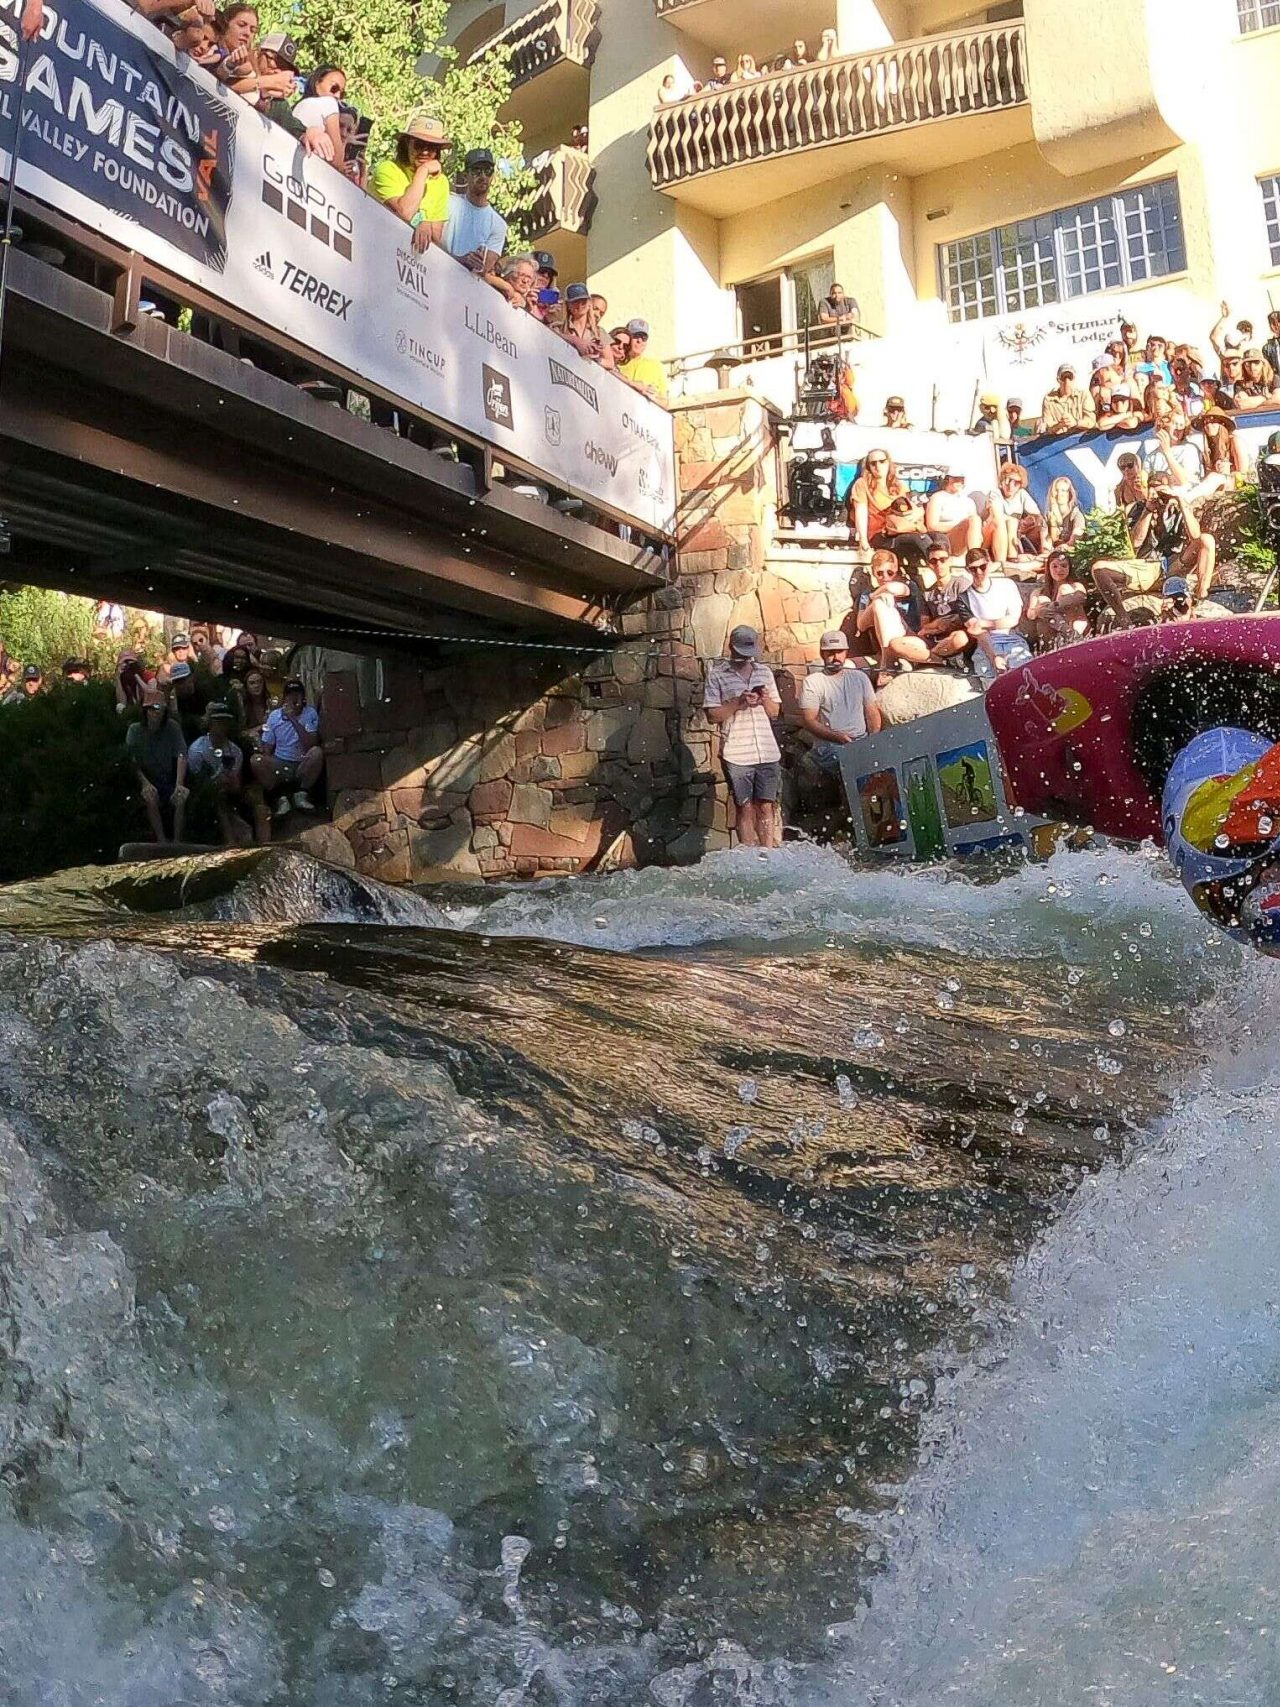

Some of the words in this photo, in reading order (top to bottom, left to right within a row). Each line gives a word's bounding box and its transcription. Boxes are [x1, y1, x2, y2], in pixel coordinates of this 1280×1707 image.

[22, 108, 89, 162] VALLEY
[93, 150, 209, 238] FOUNDATION
[263, 153, 353, 234] GoPro
[280, 260, 353, 322] TERREX
[396, 260, 429, 298] VAIL
[409, 338, 446, 371] TINCUP
[464, 305, 518, 360] L.L.Bean
[1072, 331, 1113, 344] Lodge
